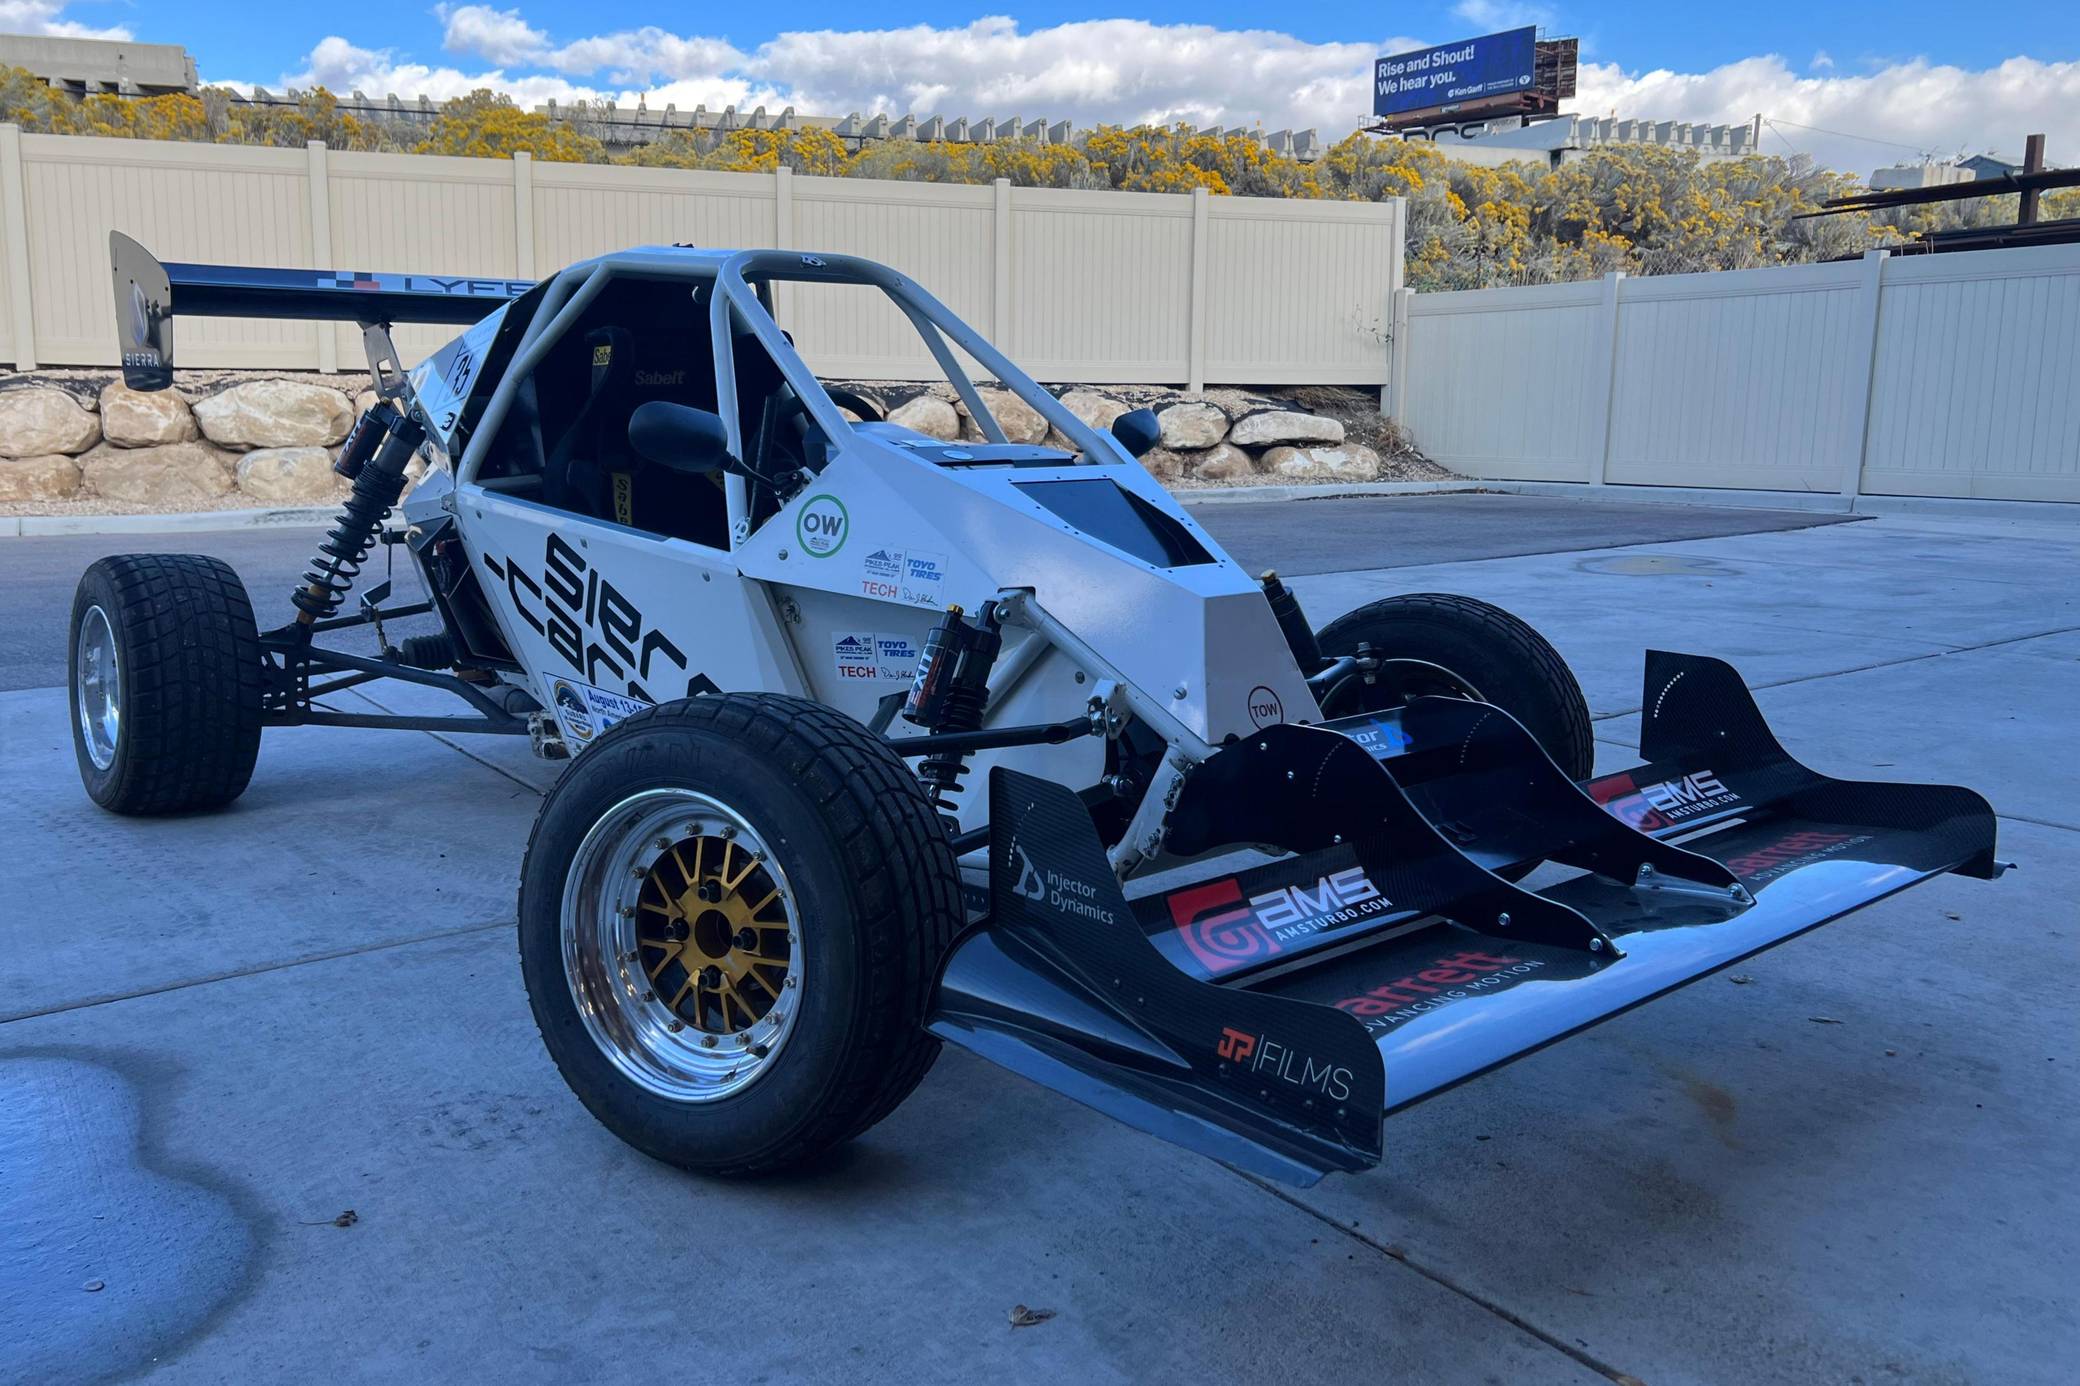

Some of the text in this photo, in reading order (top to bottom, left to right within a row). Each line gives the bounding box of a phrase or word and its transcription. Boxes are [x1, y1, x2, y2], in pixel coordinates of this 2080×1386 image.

[1379, 44, 1475, 78] Rise and Shout!
[1378, 71, 1456, 96] We hear you.
[125, 353, 159, 367] SIERRA
[634, 370, 687, 386] Sabelt
[803, 513, 843, 537] OW
[907, 559, 936, 571] TOYO
[910, 568, 944, 581] TIRES
[862, 581, 898, 598] TECH
[878, 641, 907, 649] TOYO
[883, 649, 916, 657] TIRES
[838, 666, 876, 678] TECH
[588, 689, 620, 711] August
[1251, 703, 1277, 718] TOW
[1666, 793, 1743, 820] AMSTURBO.COM
[1047, 870, 1097, 899] Injector
[1050, 890, 1114, 925] Dynamics
[1276, 897, 1393, 942] AMSTURBO.COM
[1334, 951, 1521, 1016] arrett
[1465, 959, 1545, 991] MOTION
[1258, 1040, 1354, 1101] FILMS
